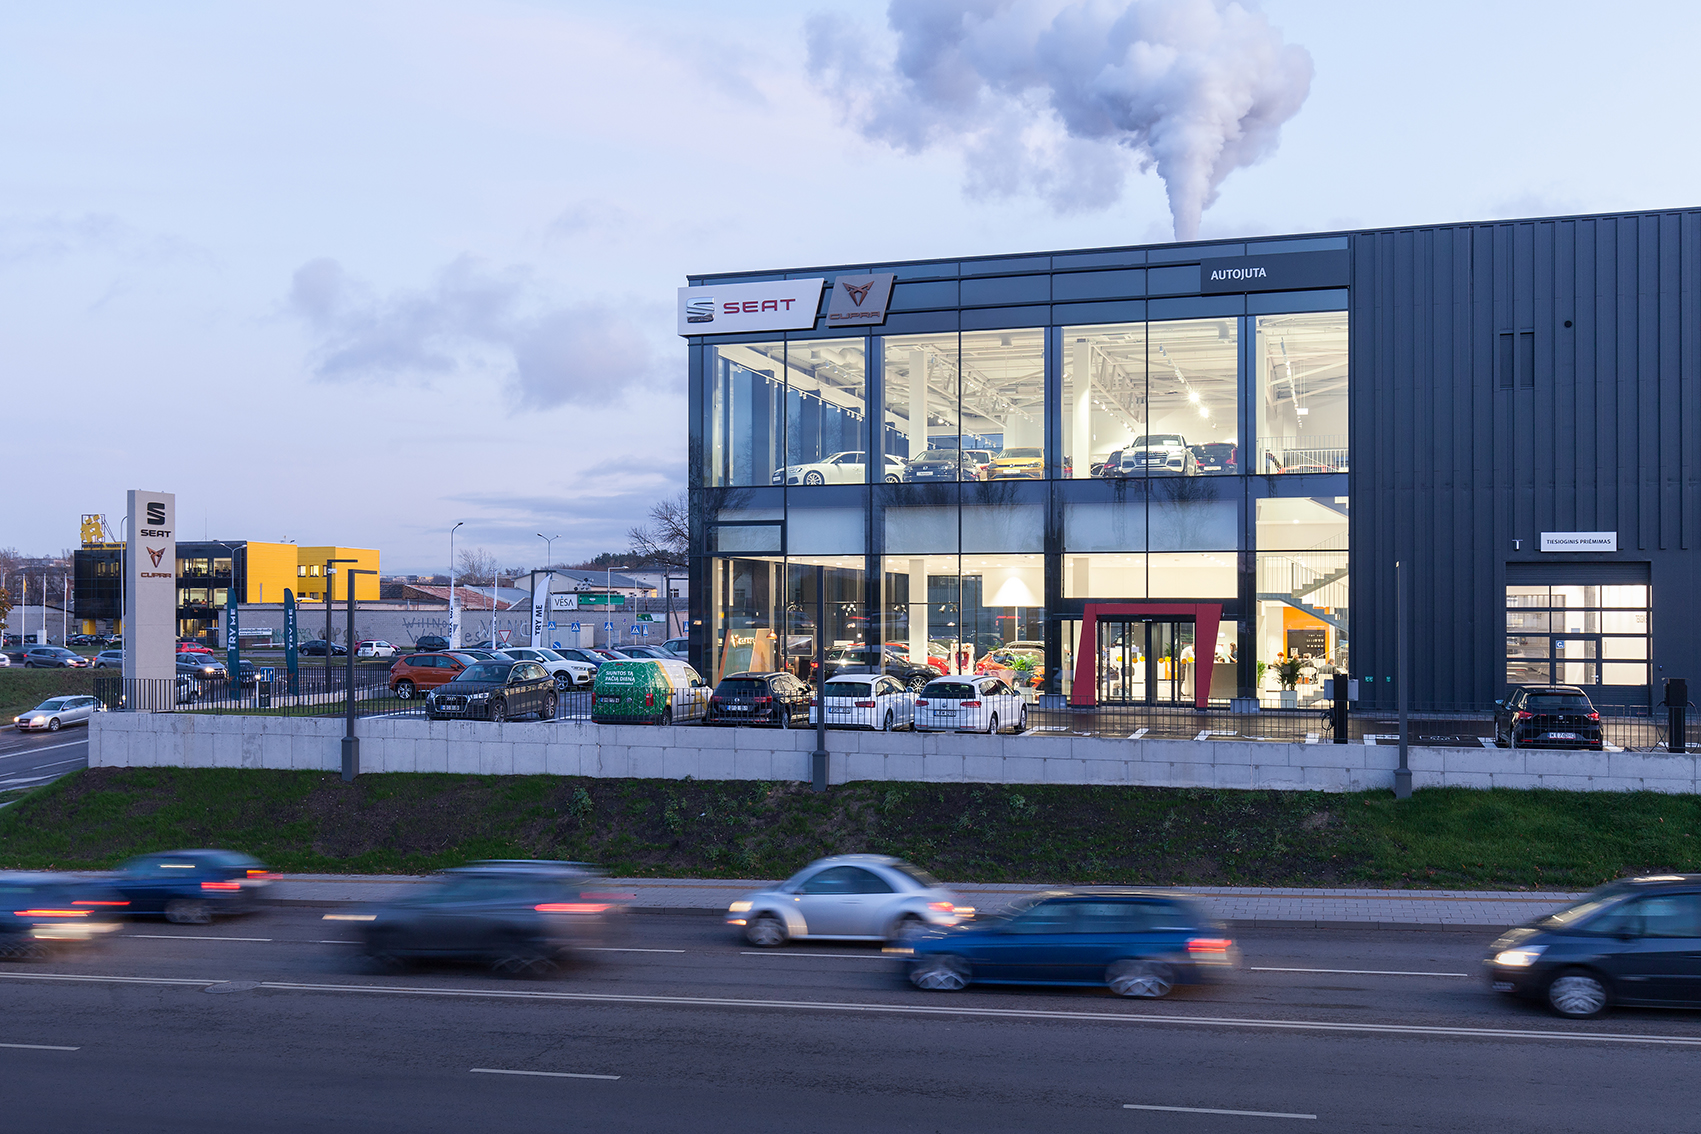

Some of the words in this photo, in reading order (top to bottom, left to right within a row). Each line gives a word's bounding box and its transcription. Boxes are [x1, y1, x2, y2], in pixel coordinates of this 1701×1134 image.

[1210, 267, 1267, 280] AUTOJUTA
[723, 298, 796, 315] SEAT
[829, 311, 881, 320] CUPRA
[140, 529, 172, 538] SEAT
[140, 571, 172, 579] CUPRA
[229, 608, 236, 626] ME
[535, 604, 543, 618] ME
[534, 619, 542, 636] TRY
[227, 627, 236, 652] TRY
